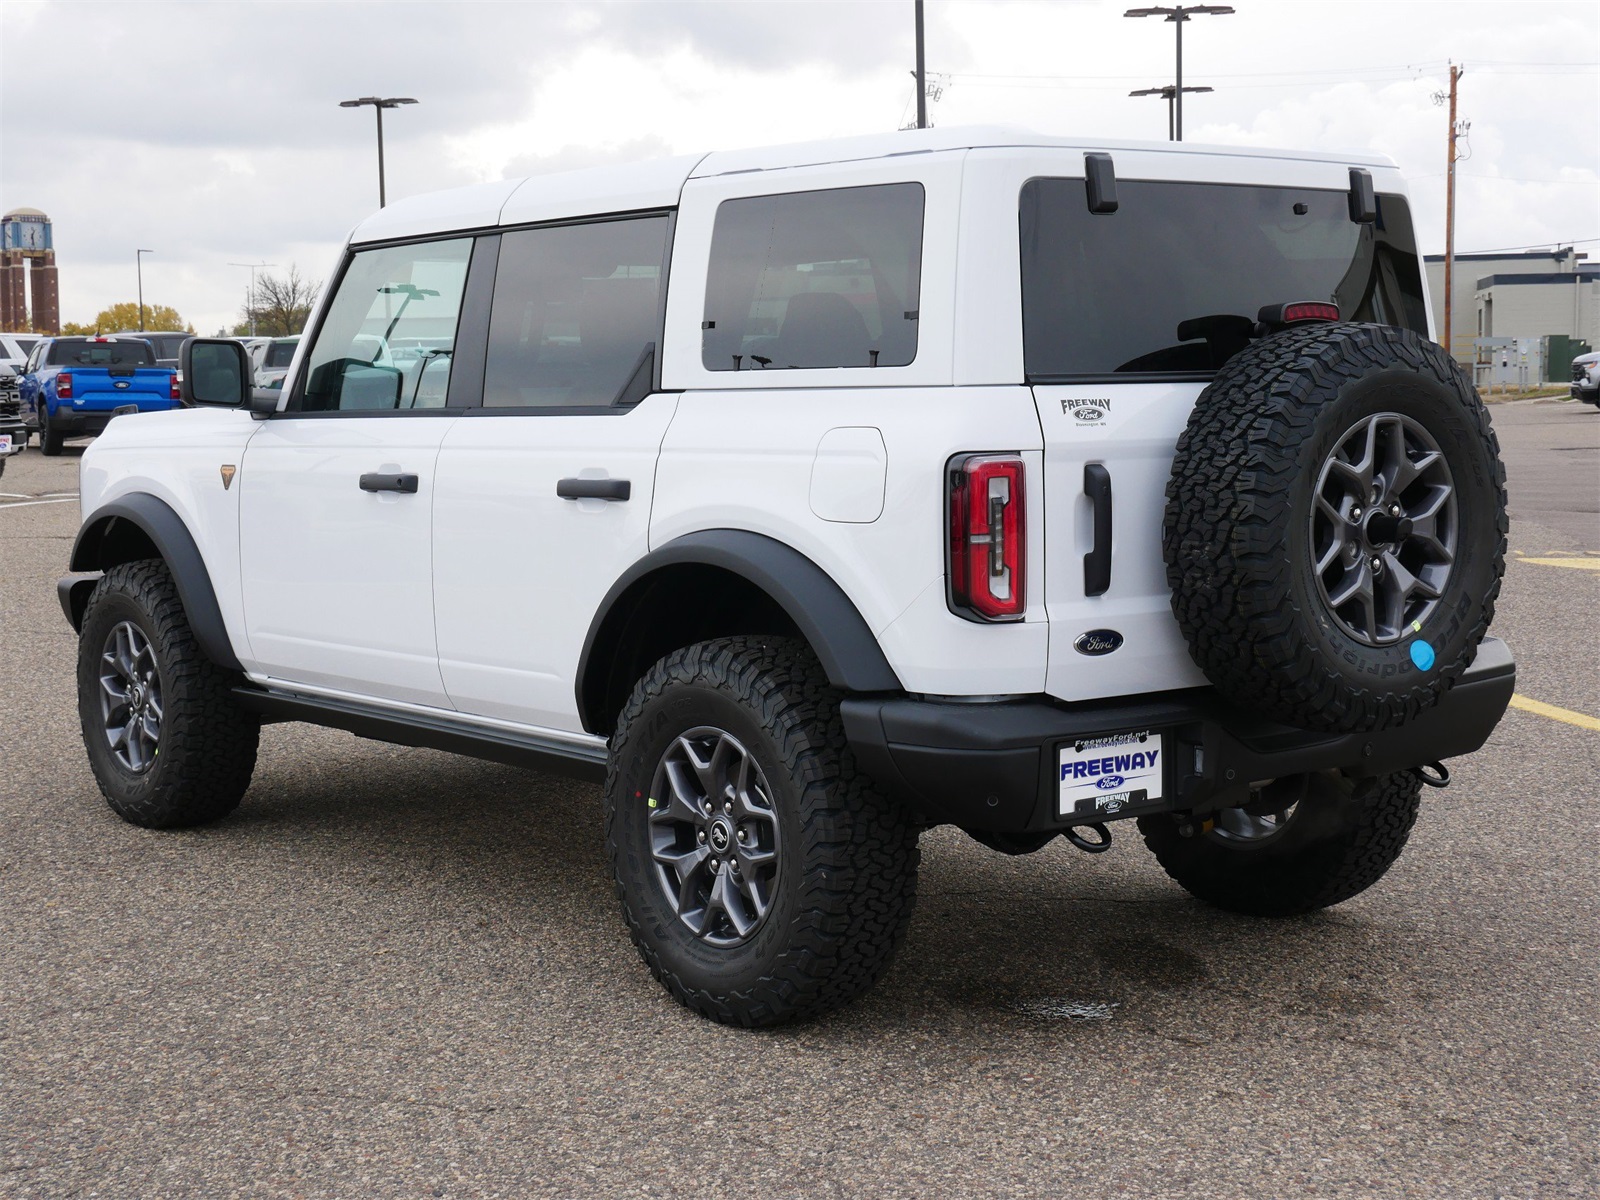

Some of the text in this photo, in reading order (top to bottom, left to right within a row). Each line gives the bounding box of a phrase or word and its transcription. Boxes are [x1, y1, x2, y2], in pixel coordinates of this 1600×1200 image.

[1060, 398, 1111, 414] FREEWAY
[1078, 409, 1099, 420] Ford
[1087, 636, 1113, 650] Ford
[1328, 591, 1473, 680] BFGodrich
[1060, 749, 1159, 781] FREEWAY
[1100, 777, 1119, 789] Ford
[1095, 791, 1130, 810] FREEWAY
